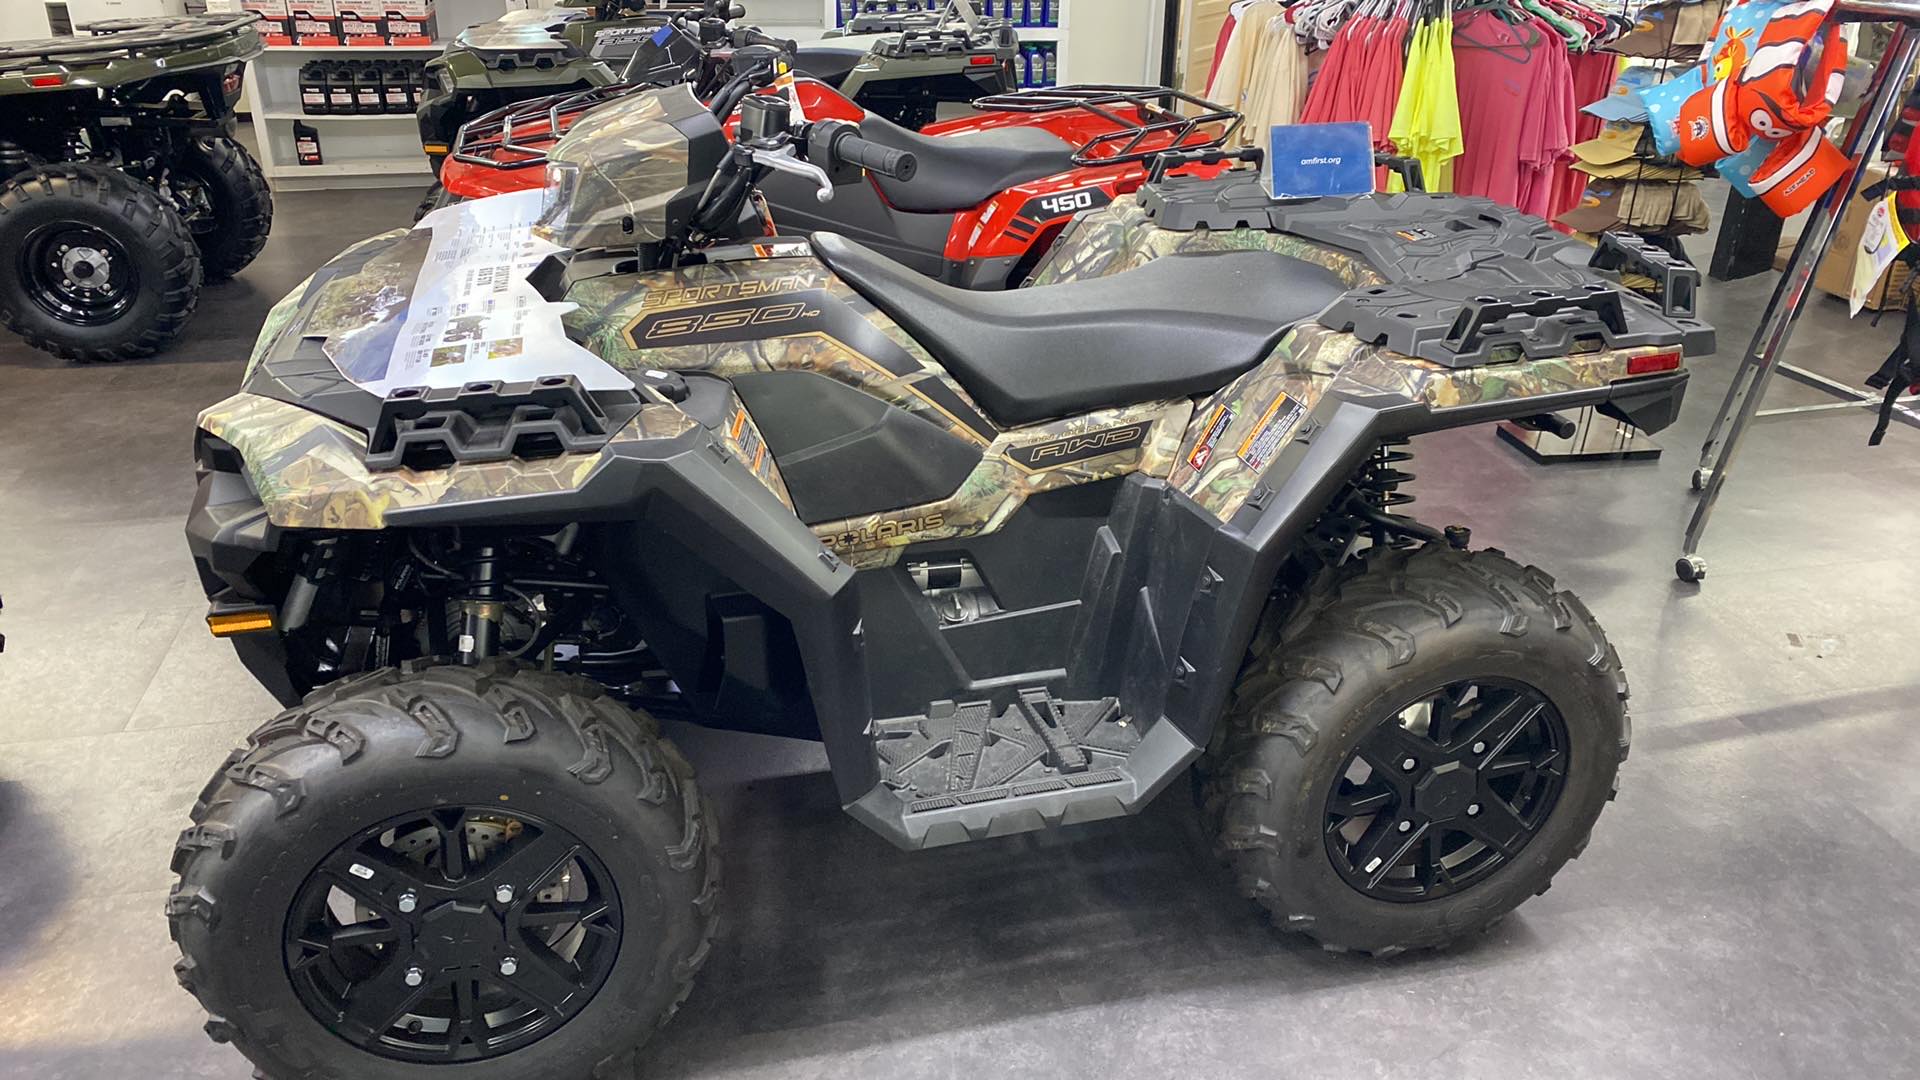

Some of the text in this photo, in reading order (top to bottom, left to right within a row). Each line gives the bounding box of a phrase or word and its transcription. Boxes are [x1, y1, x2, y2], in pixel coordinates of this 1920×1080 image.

[1300, 156, 1341, 166] amfirst.org
[1041, 191, 1092, 214] 450
[641, 273, 816, 308] SPORTSMAN
[645, 302, 806, 339] 850
[1030, 426, 1141, 462] AWD
[818, 513, 945, 547] POLARIS
